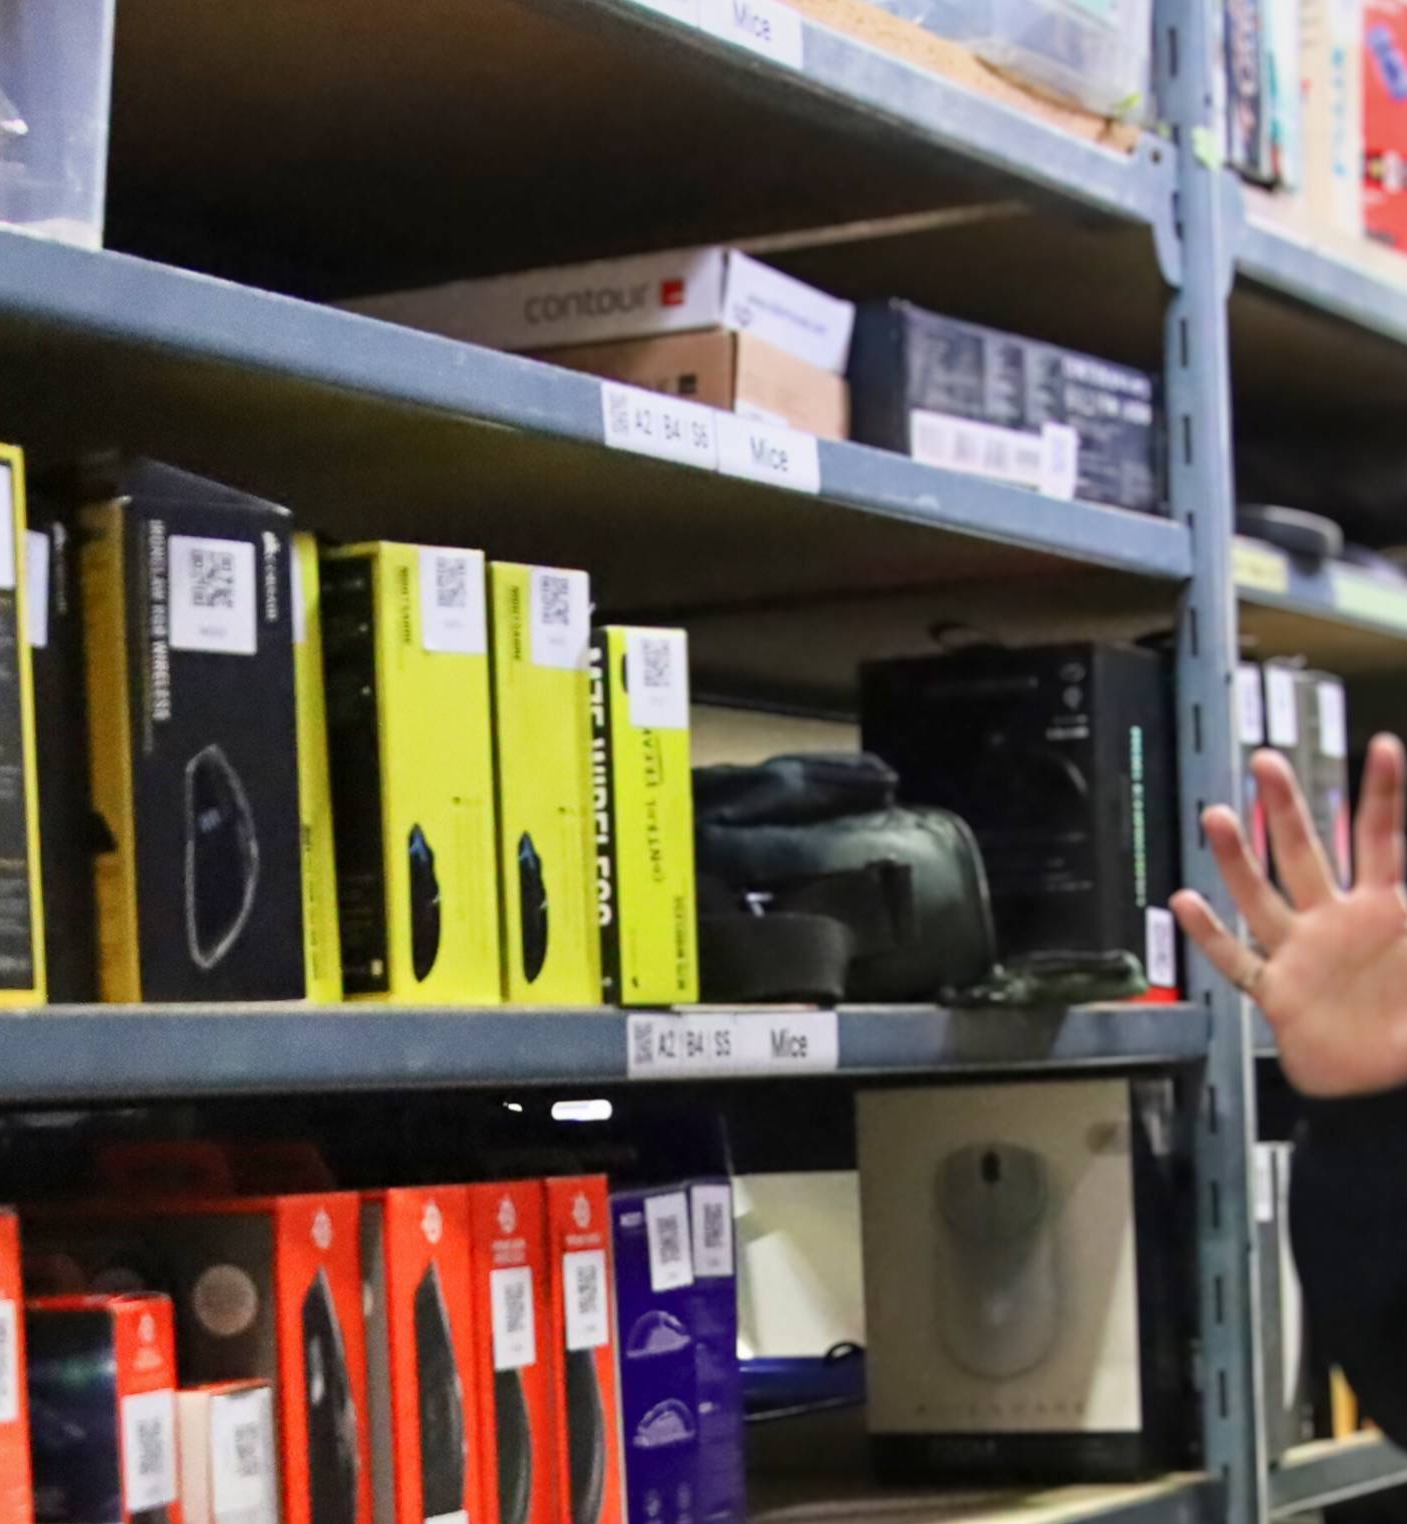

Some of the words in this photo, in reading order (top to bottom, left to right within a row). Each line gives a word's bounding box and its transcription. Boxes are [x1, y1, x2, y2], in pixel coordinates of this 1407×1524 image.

[524, 282, 649, 325] contour
[749, 435, 789, 473] Mice
[657, 1029, 676, 1058] A2
[686, 1029, 704, 1058] B4
[714, 1029, 731, 1057] S5
[771, 1028, 808, 1058] Mice
